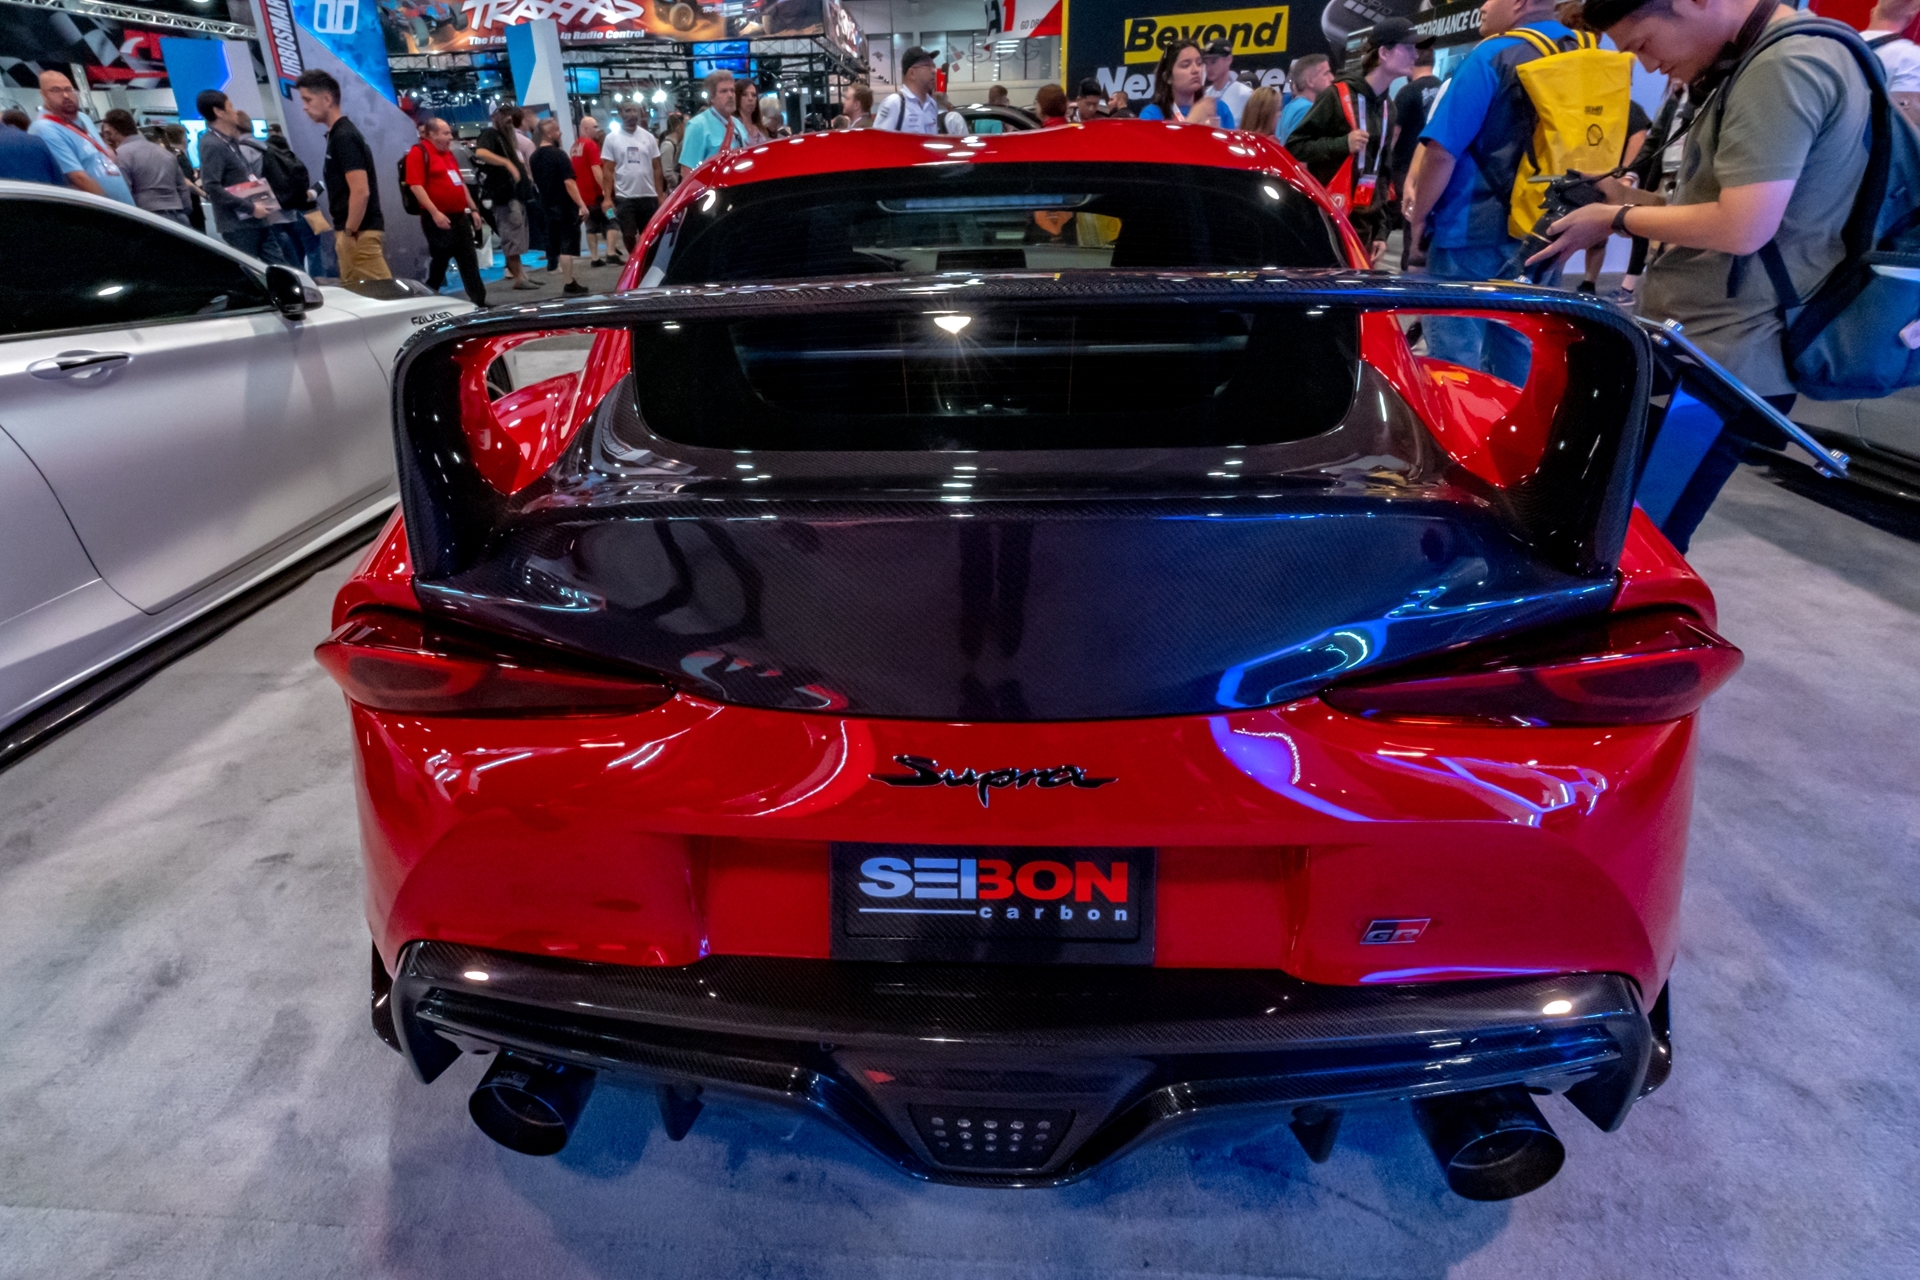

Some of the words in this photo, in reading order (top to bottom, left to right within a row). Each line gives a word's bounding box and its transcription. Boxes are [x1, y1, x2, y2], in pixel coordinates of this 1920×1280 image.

[461, 0, 645, 30] TRAXXAS
[469, 36, 487, 46] The
[490, 35, 507, 44] Fas
[560, 31, 569, 40] In
[573, 30, 604, 40] Radio
[605, 29, 645, 39] Control
[868, 754, 1119, 808] Supra
[859, 857, 1128, 903] SEIBON
[979, 905, 1127, 921] carbon
[1364, 928, 1420, 943] GR
